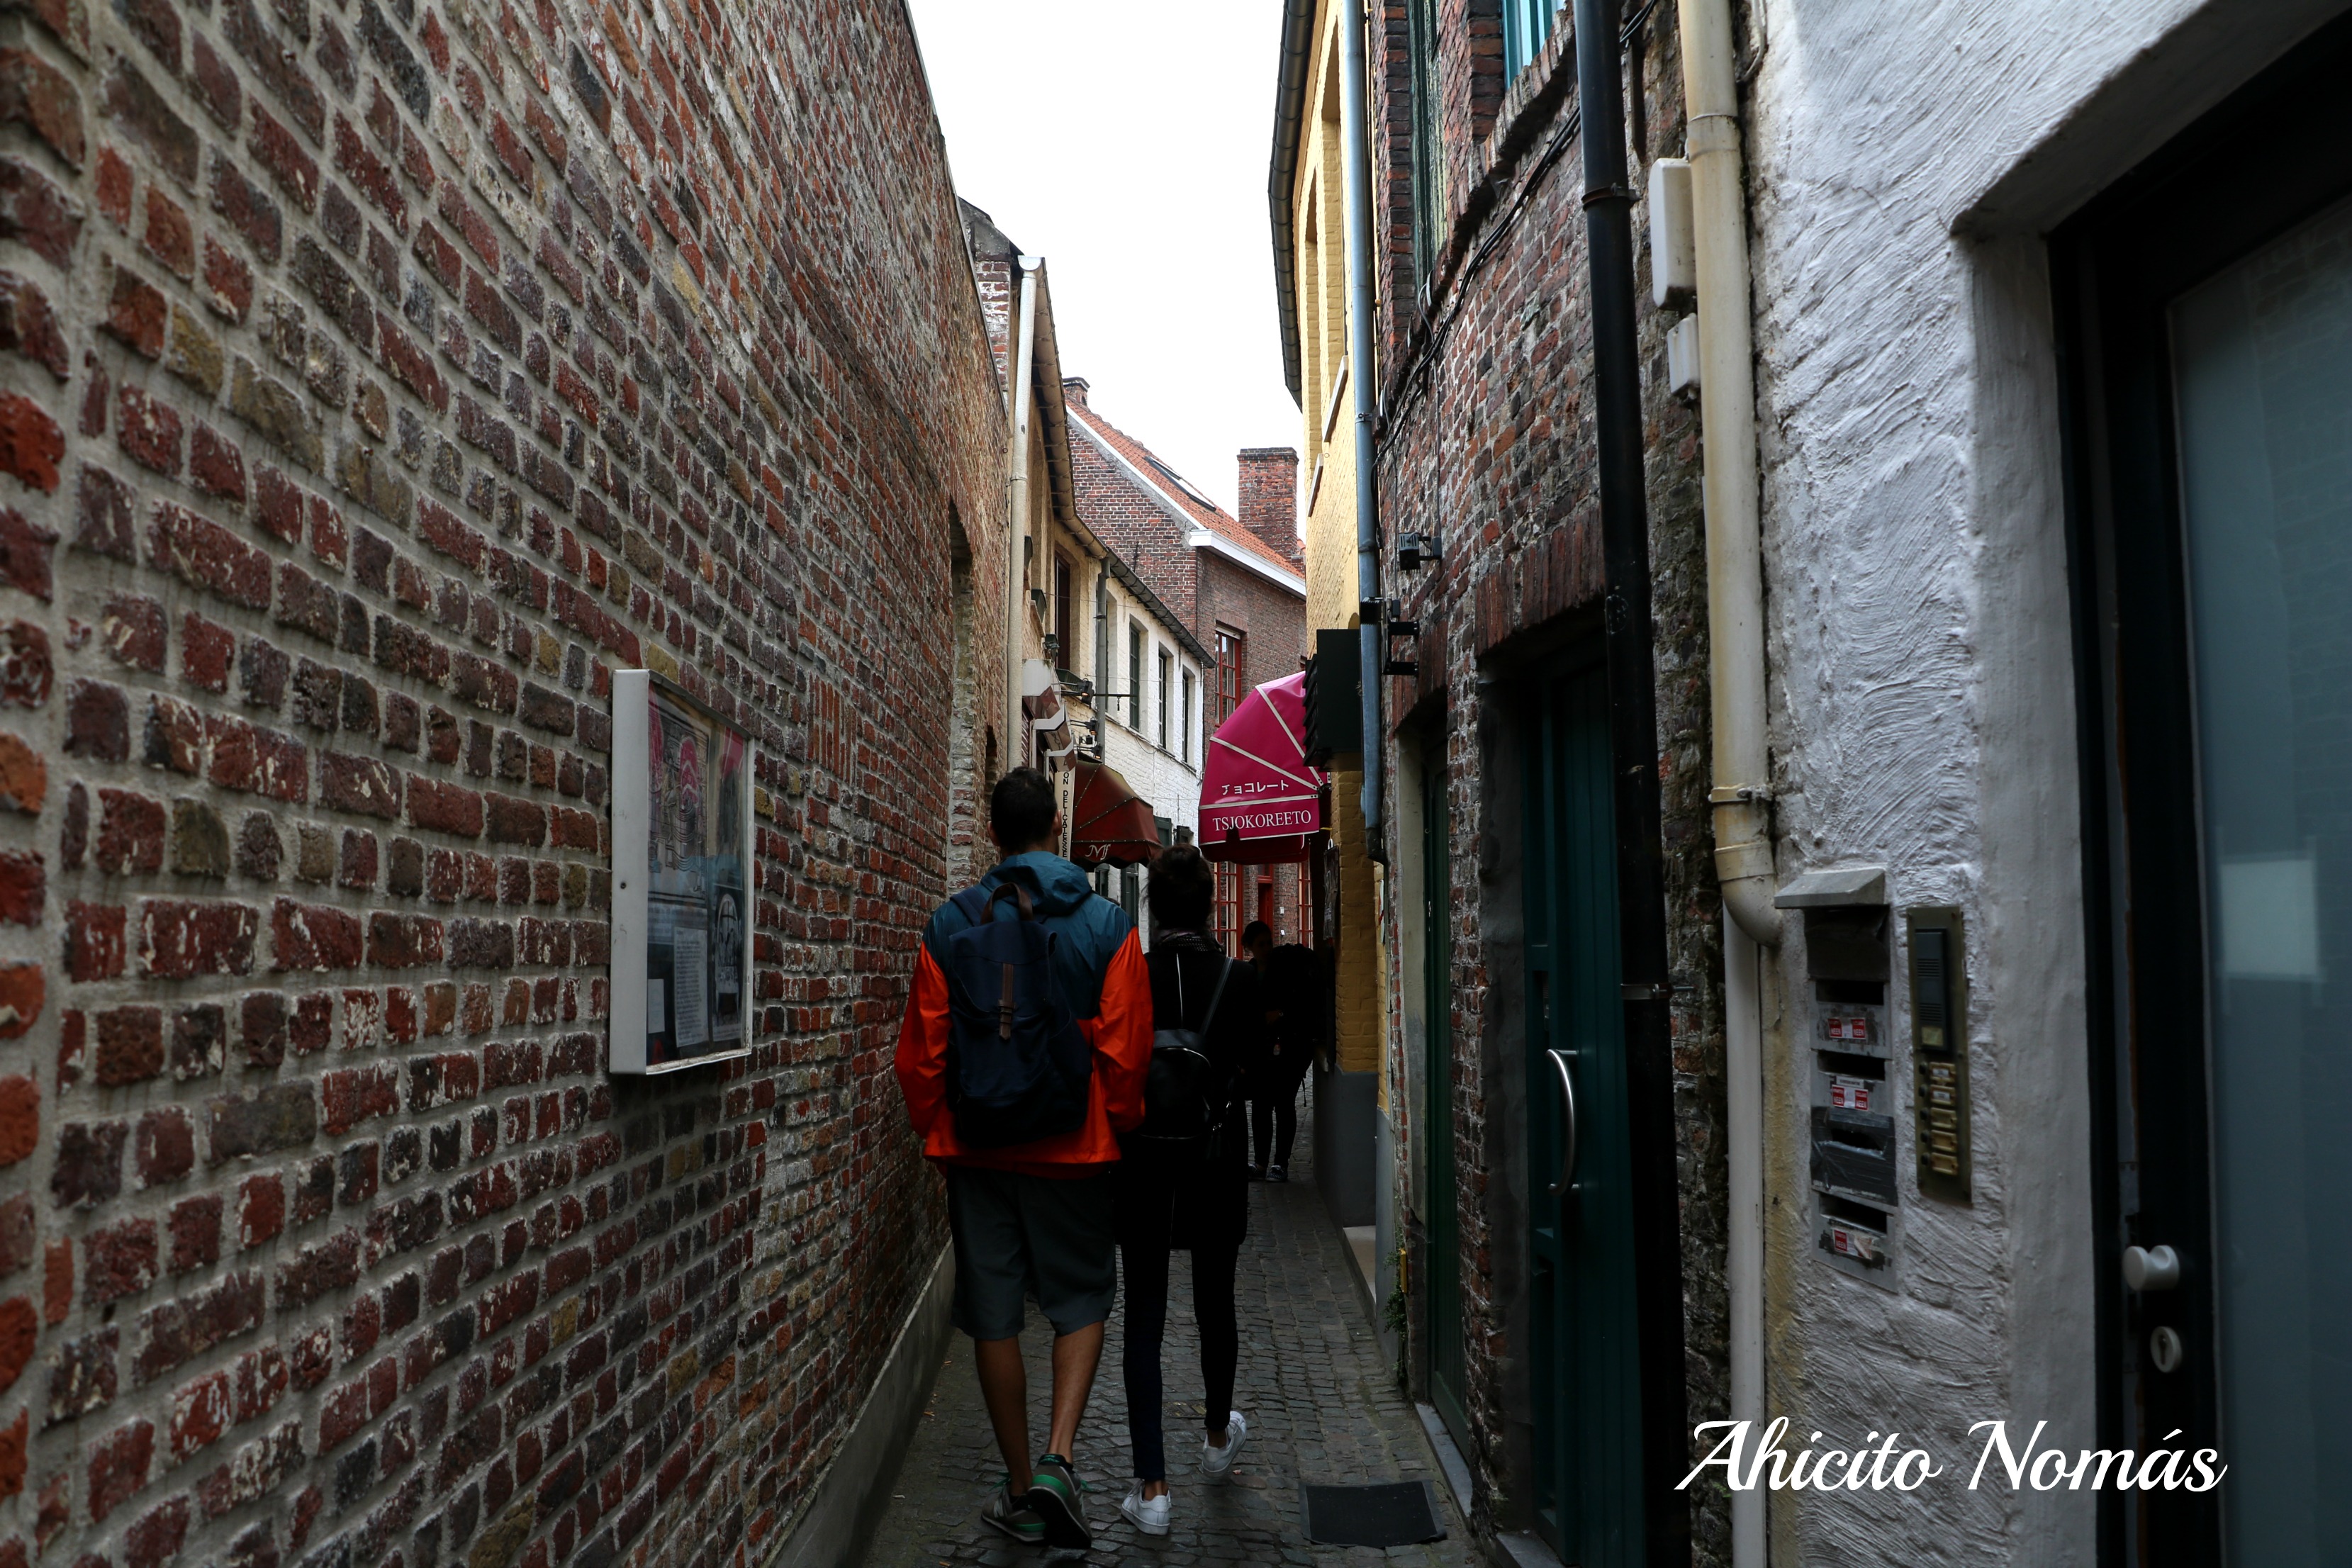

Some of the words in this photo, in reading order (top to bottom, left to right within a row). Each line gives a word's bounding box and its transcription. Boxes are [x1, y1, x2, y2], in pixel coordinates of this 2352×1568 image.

[1221, 780, 1289, 795] チョコレート
[1212, 810, 1311, 831] TSJOKOREETO
